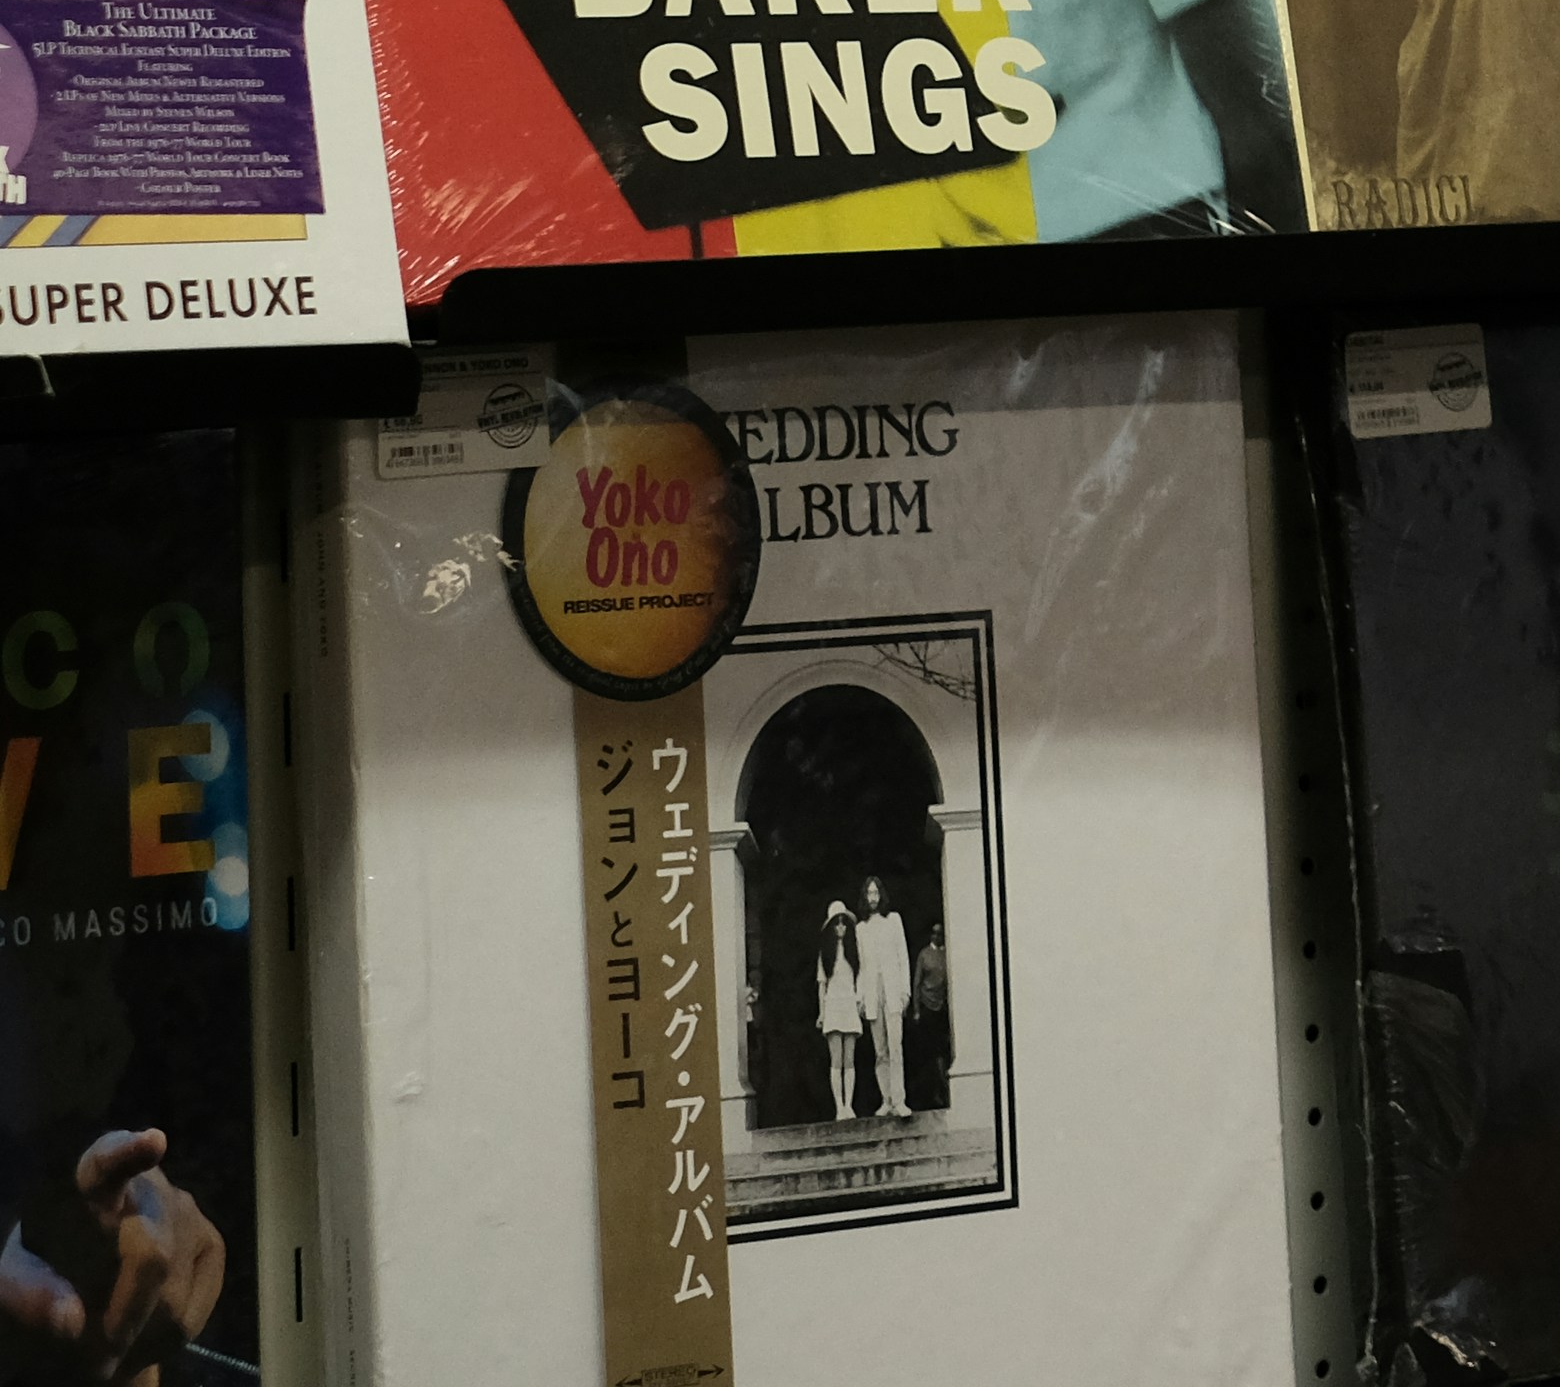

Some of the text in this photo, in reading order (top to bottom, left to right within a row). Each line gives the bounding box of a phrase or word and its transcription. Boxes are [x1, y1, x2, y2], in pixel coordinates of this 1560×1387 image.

[63, 20, 258, 40] BLACK SABBATH PACKAGE
[138, 2, 217, 21] ULTIMATE
[639, 36, 1058, 159] SINGS
[1331, 173, 1475, 229] RADICI
[0, 275, 319, 326] UPER DELUXE
[577, 466, 692, 529] Yoko
[764, 478, 933, 543] LBUM
[587, 526, 678, 590] Ono
[563, 589, 715, 615] REISSUE PROJECT
[53, 895, 219, 943] MASSIMO
[595, 739, 647, 1113] ジョンとヨーコ
[650, 735, 715, 1306] ウェディング・アルバム
[643, 1363, 697, 1385] STEREO
